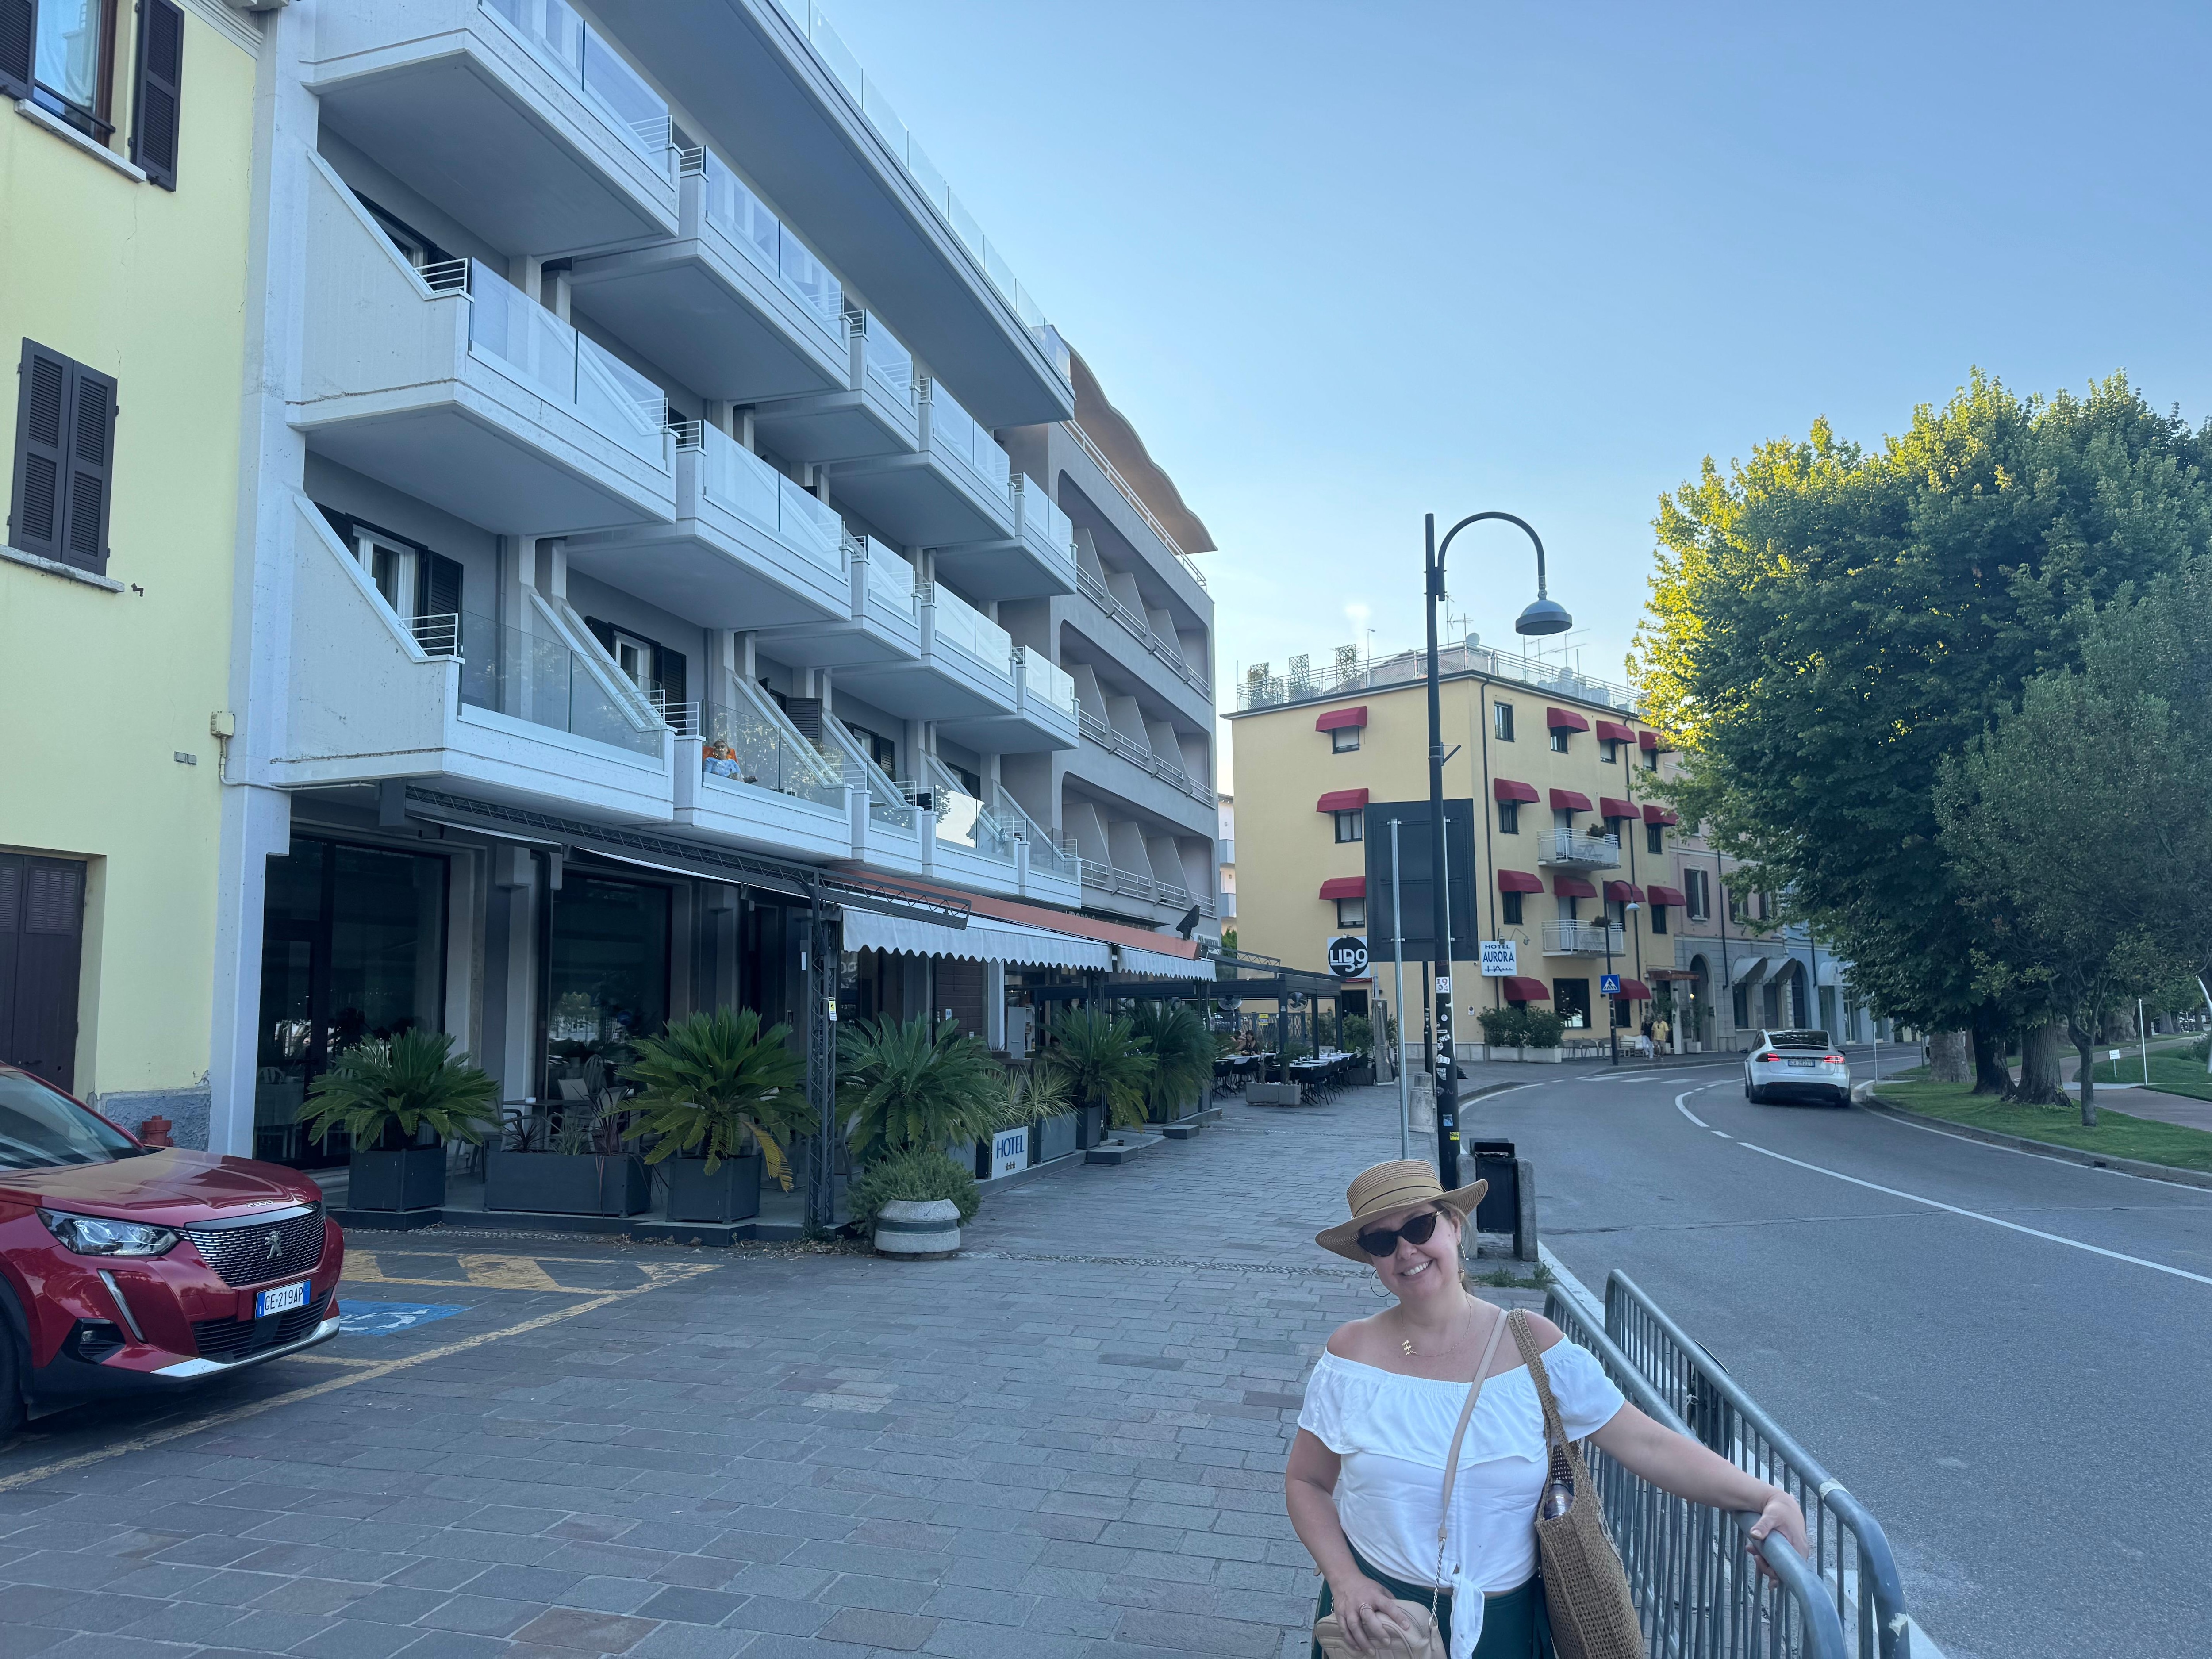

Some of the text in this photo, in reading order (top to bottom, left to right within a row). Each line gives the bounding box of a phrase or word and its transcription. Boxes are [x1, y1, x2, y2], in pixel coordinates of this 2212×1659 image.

[1483, 951, 1514, 962] AURORA
[997, 1135, 1025, 1159] HOTEL
[278, 1287, 303, 1308] 219AP
